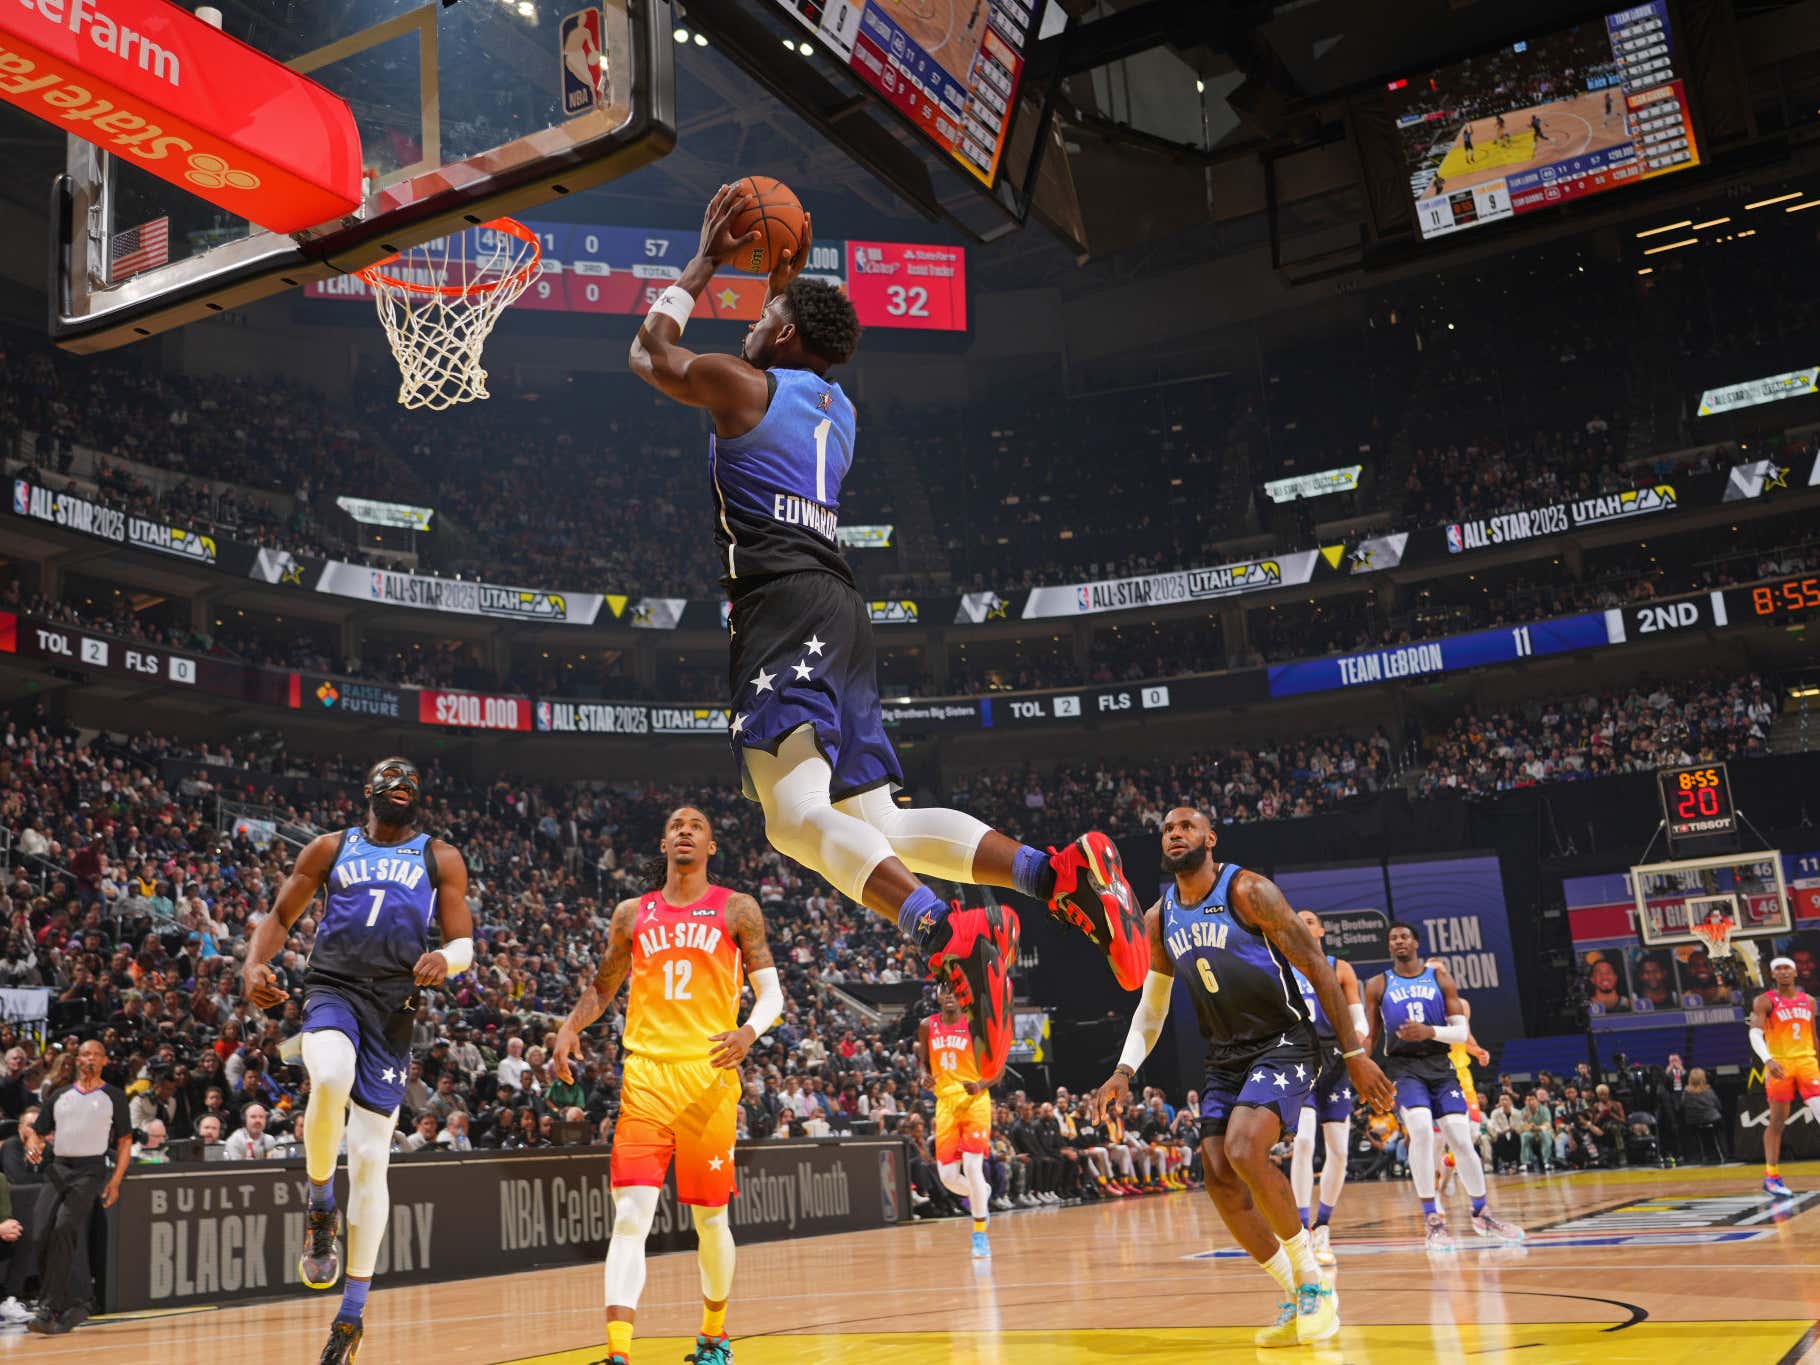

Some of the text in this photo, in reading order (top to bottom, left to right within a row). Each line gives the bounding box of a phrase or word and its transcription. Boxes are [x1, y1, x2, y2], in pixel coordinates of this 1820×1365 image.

[586, 235, 599, 253] 0
[645, 239, 669, 257] 57
[642, 266, 673, 278] TOTAL
[538, 281, 551, 299] 9
[586, 284, 599, 301] 0
[886, 285, 929, 316] 32
[814, 419, 832, 503] 1
[92, 504, 125, 542] 2023
[128, 518, 171, 547] UTAH
[1531, 505, 1569, 536] 2023
[1572, 495, 1621, 523] UTAH
[444, 583, 475, 610] 2023
[480, 587, 520, 609] UTAH
[1153, 575, 1185, 602] 2023
[1190, 569, 1232, 592] UTAH
[1752, 578, 1820, 615] 8:55
[1636, 602, 1699, 634] 2ND
[37, 628, 101, 660] TOL 2
[1337, 653, 1382, 685] TEAM
[1512, 626, 1532, 657] 11
[125, 650, 188, 678] FLS 0
[342, 683, 382, 700] RAISE
[1099, 690, 1161, 711] FLS 0
[341, 699, 400, 717] FUTURE
[436, 694, 518, 729] $200,000
[615, 707, 648, 734] 2023
[651, 709, 694, 729] UTAH
[1010, 700, 1072, 719] TOL 2
[1679, 770, 1719, 790] 8:55
[1678, 787, 1719, 818] 20
[1689, 818, 1731, 831] TISSOT
[1753, 858, 1818, 876] 46 11
[366, 889, 386, 927] 7
[1759, 900, 1778, 912] 46
[1342, 919, 1383, 931] Brothers
[1343, 932, 1378, 945] Sisters
[1423, 916, 1482, 953] TEAM
[662, 960, 692, 1000] 12
[1196, 957, 1219, 993] 6
[1406, 1002, 1425, 1024] 13
[1792, 1022, 1801, 1040] 2
[940, 1052, 957, 1071] 43
[151, 1185, 255, 1214] BUILT
[500, 1179, 546, 1250] NBA
[735, 1167, 796, 1230] History
[798, 1160, 849, 1219] Month
[150, 1214, 268, 1300] BLACK
